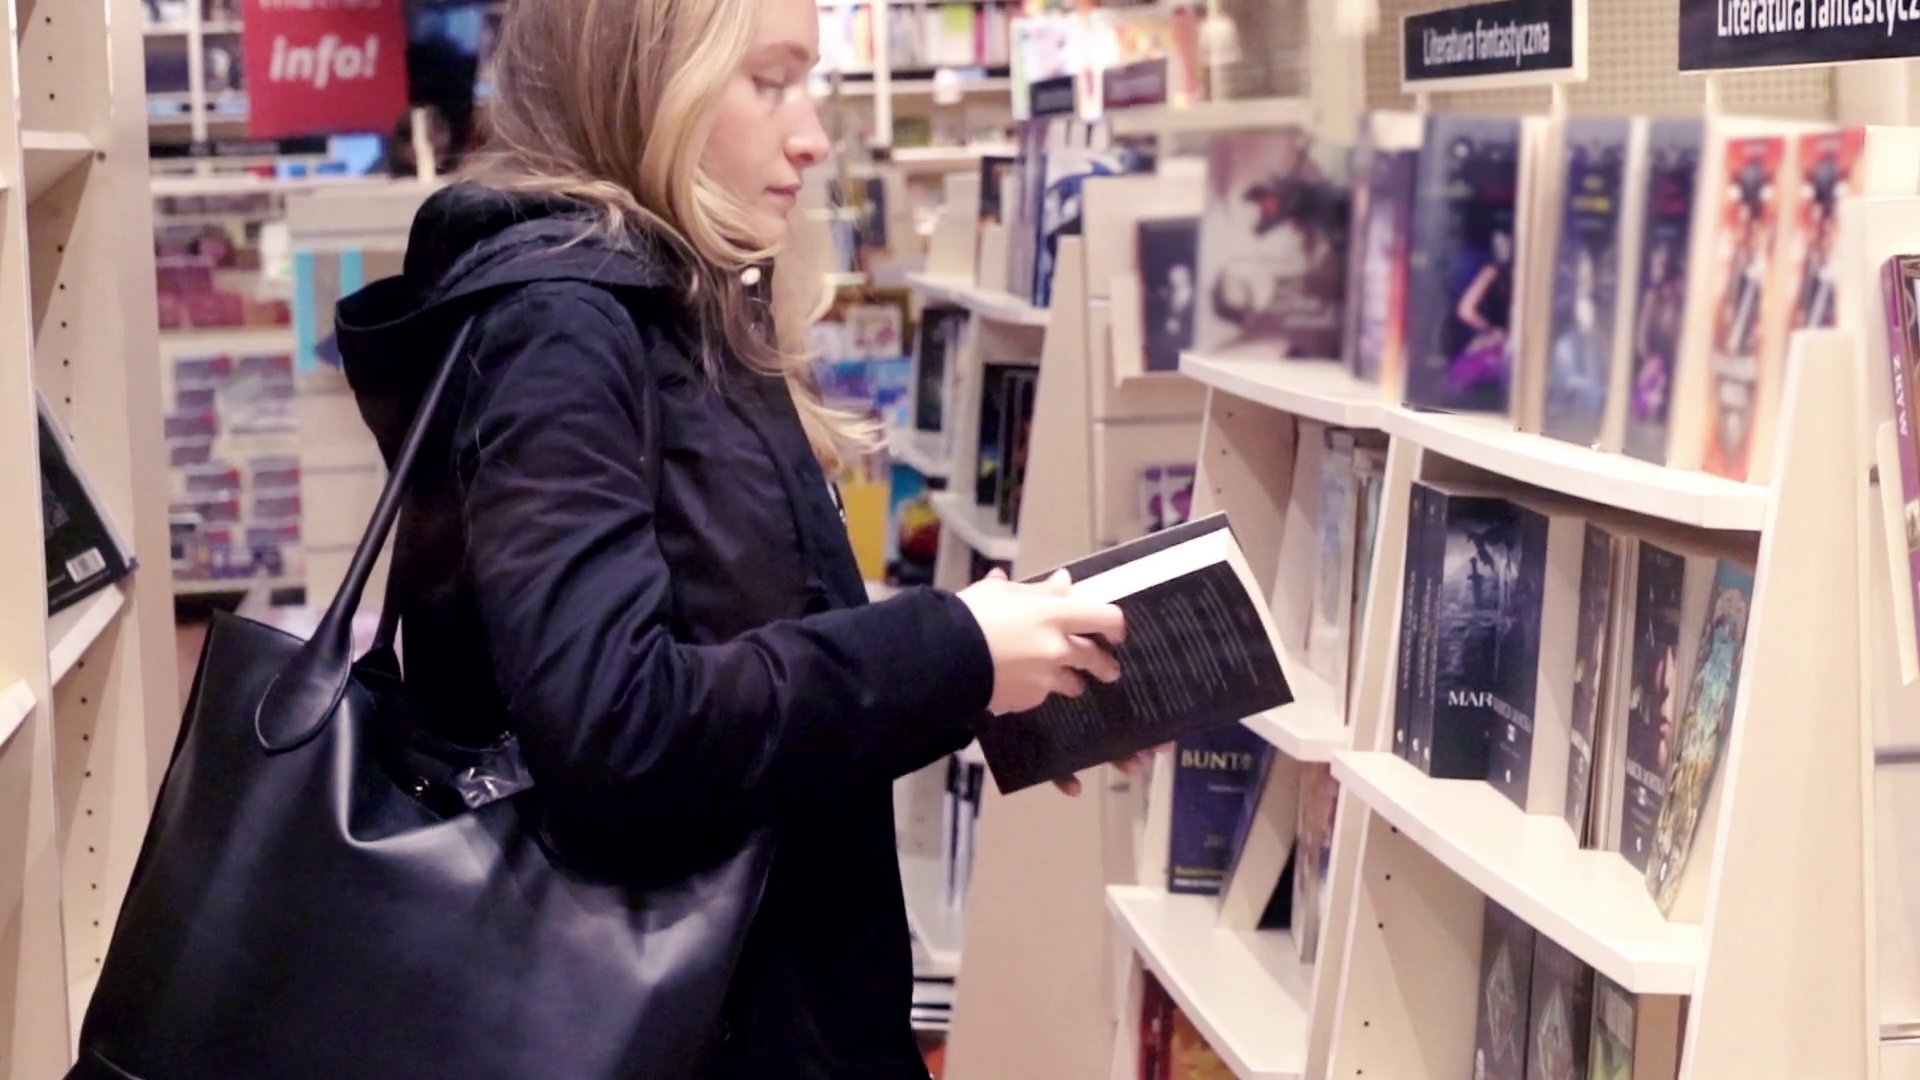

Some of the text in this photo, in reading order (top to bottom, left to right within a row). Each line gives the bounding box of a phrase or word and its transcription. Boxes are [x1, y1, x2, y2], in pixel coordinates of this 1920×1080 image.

[1423, 18, 1550, 67] Literatura fantastyczna
[1718, 0, 1805, 37] Literatura
[269, 33, 381, 89] info!
